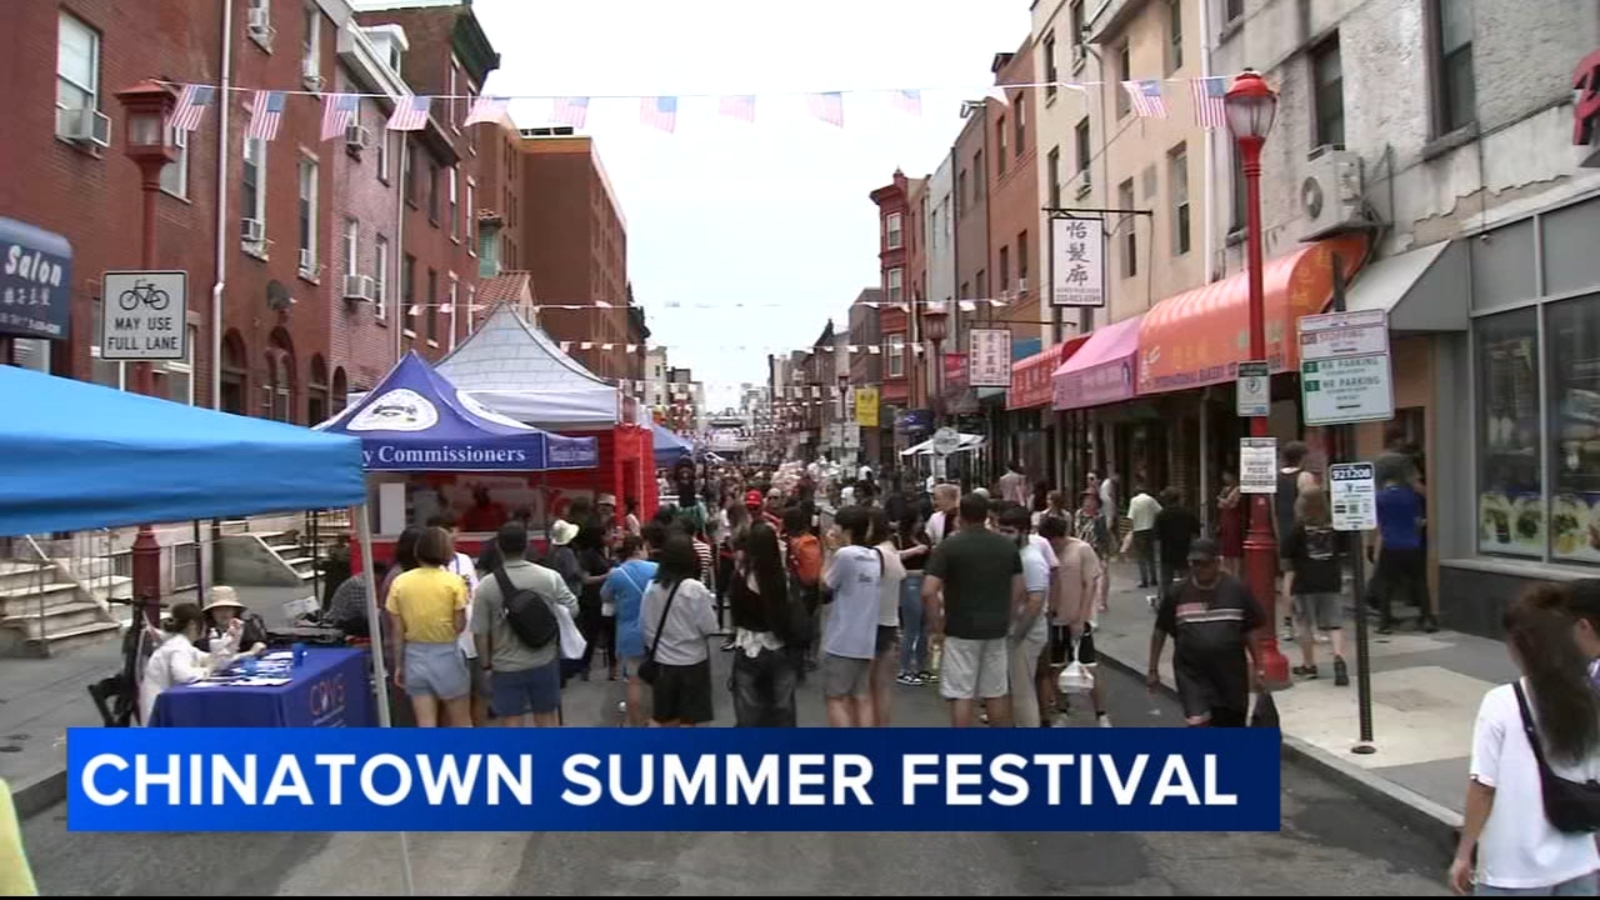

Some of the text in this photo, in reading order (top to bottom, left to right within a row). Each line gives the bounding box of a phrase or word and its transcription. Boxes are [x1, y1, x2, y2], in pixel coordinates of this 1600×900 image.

[5, 245, 62, 288] Salon
[115, 317, 172, 331] MAY USE
[107, 336, 179, 351] FULL LANE
[1338, 356, 1380, 367] PARKING
[1339, 375, 1381, 387] PARKING
[378, 445, 526, 463] Commissioners
